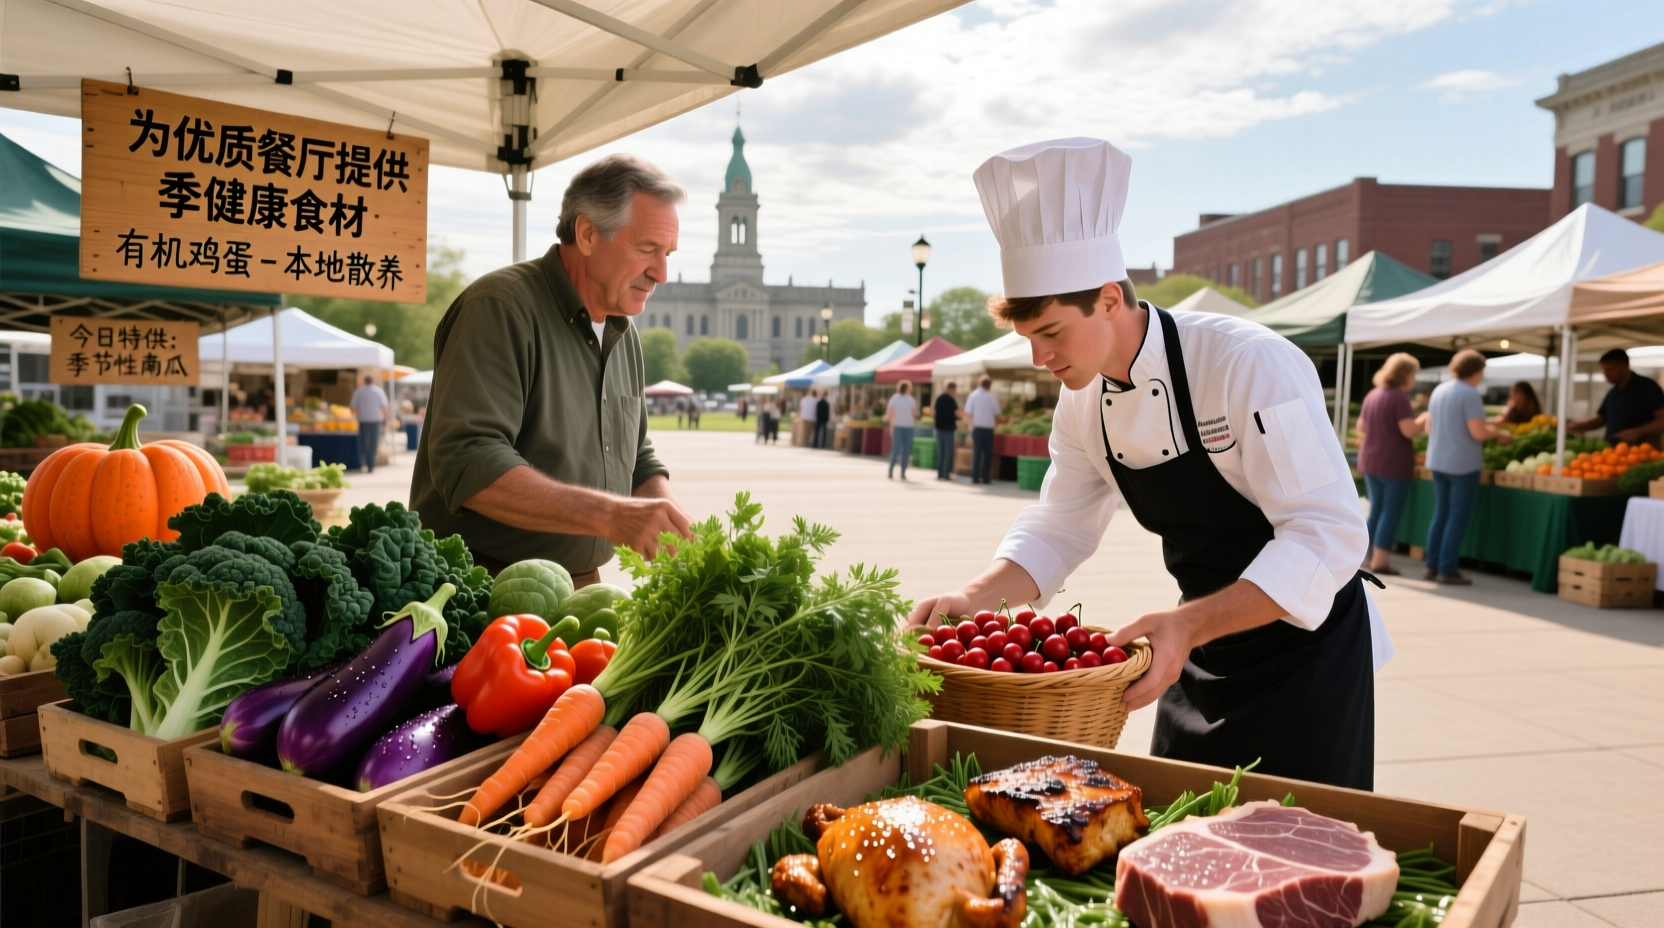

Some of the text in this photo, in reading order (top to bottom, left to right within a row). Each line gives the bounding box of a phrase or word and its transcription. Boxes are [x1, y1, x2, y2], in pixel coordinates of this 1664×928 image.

[128, 109, 410, 193] 为优质餐厅提供
[158, 171, 368, 238] 季健康食材
[66, 350, 188, 377] 季节性南瓜
